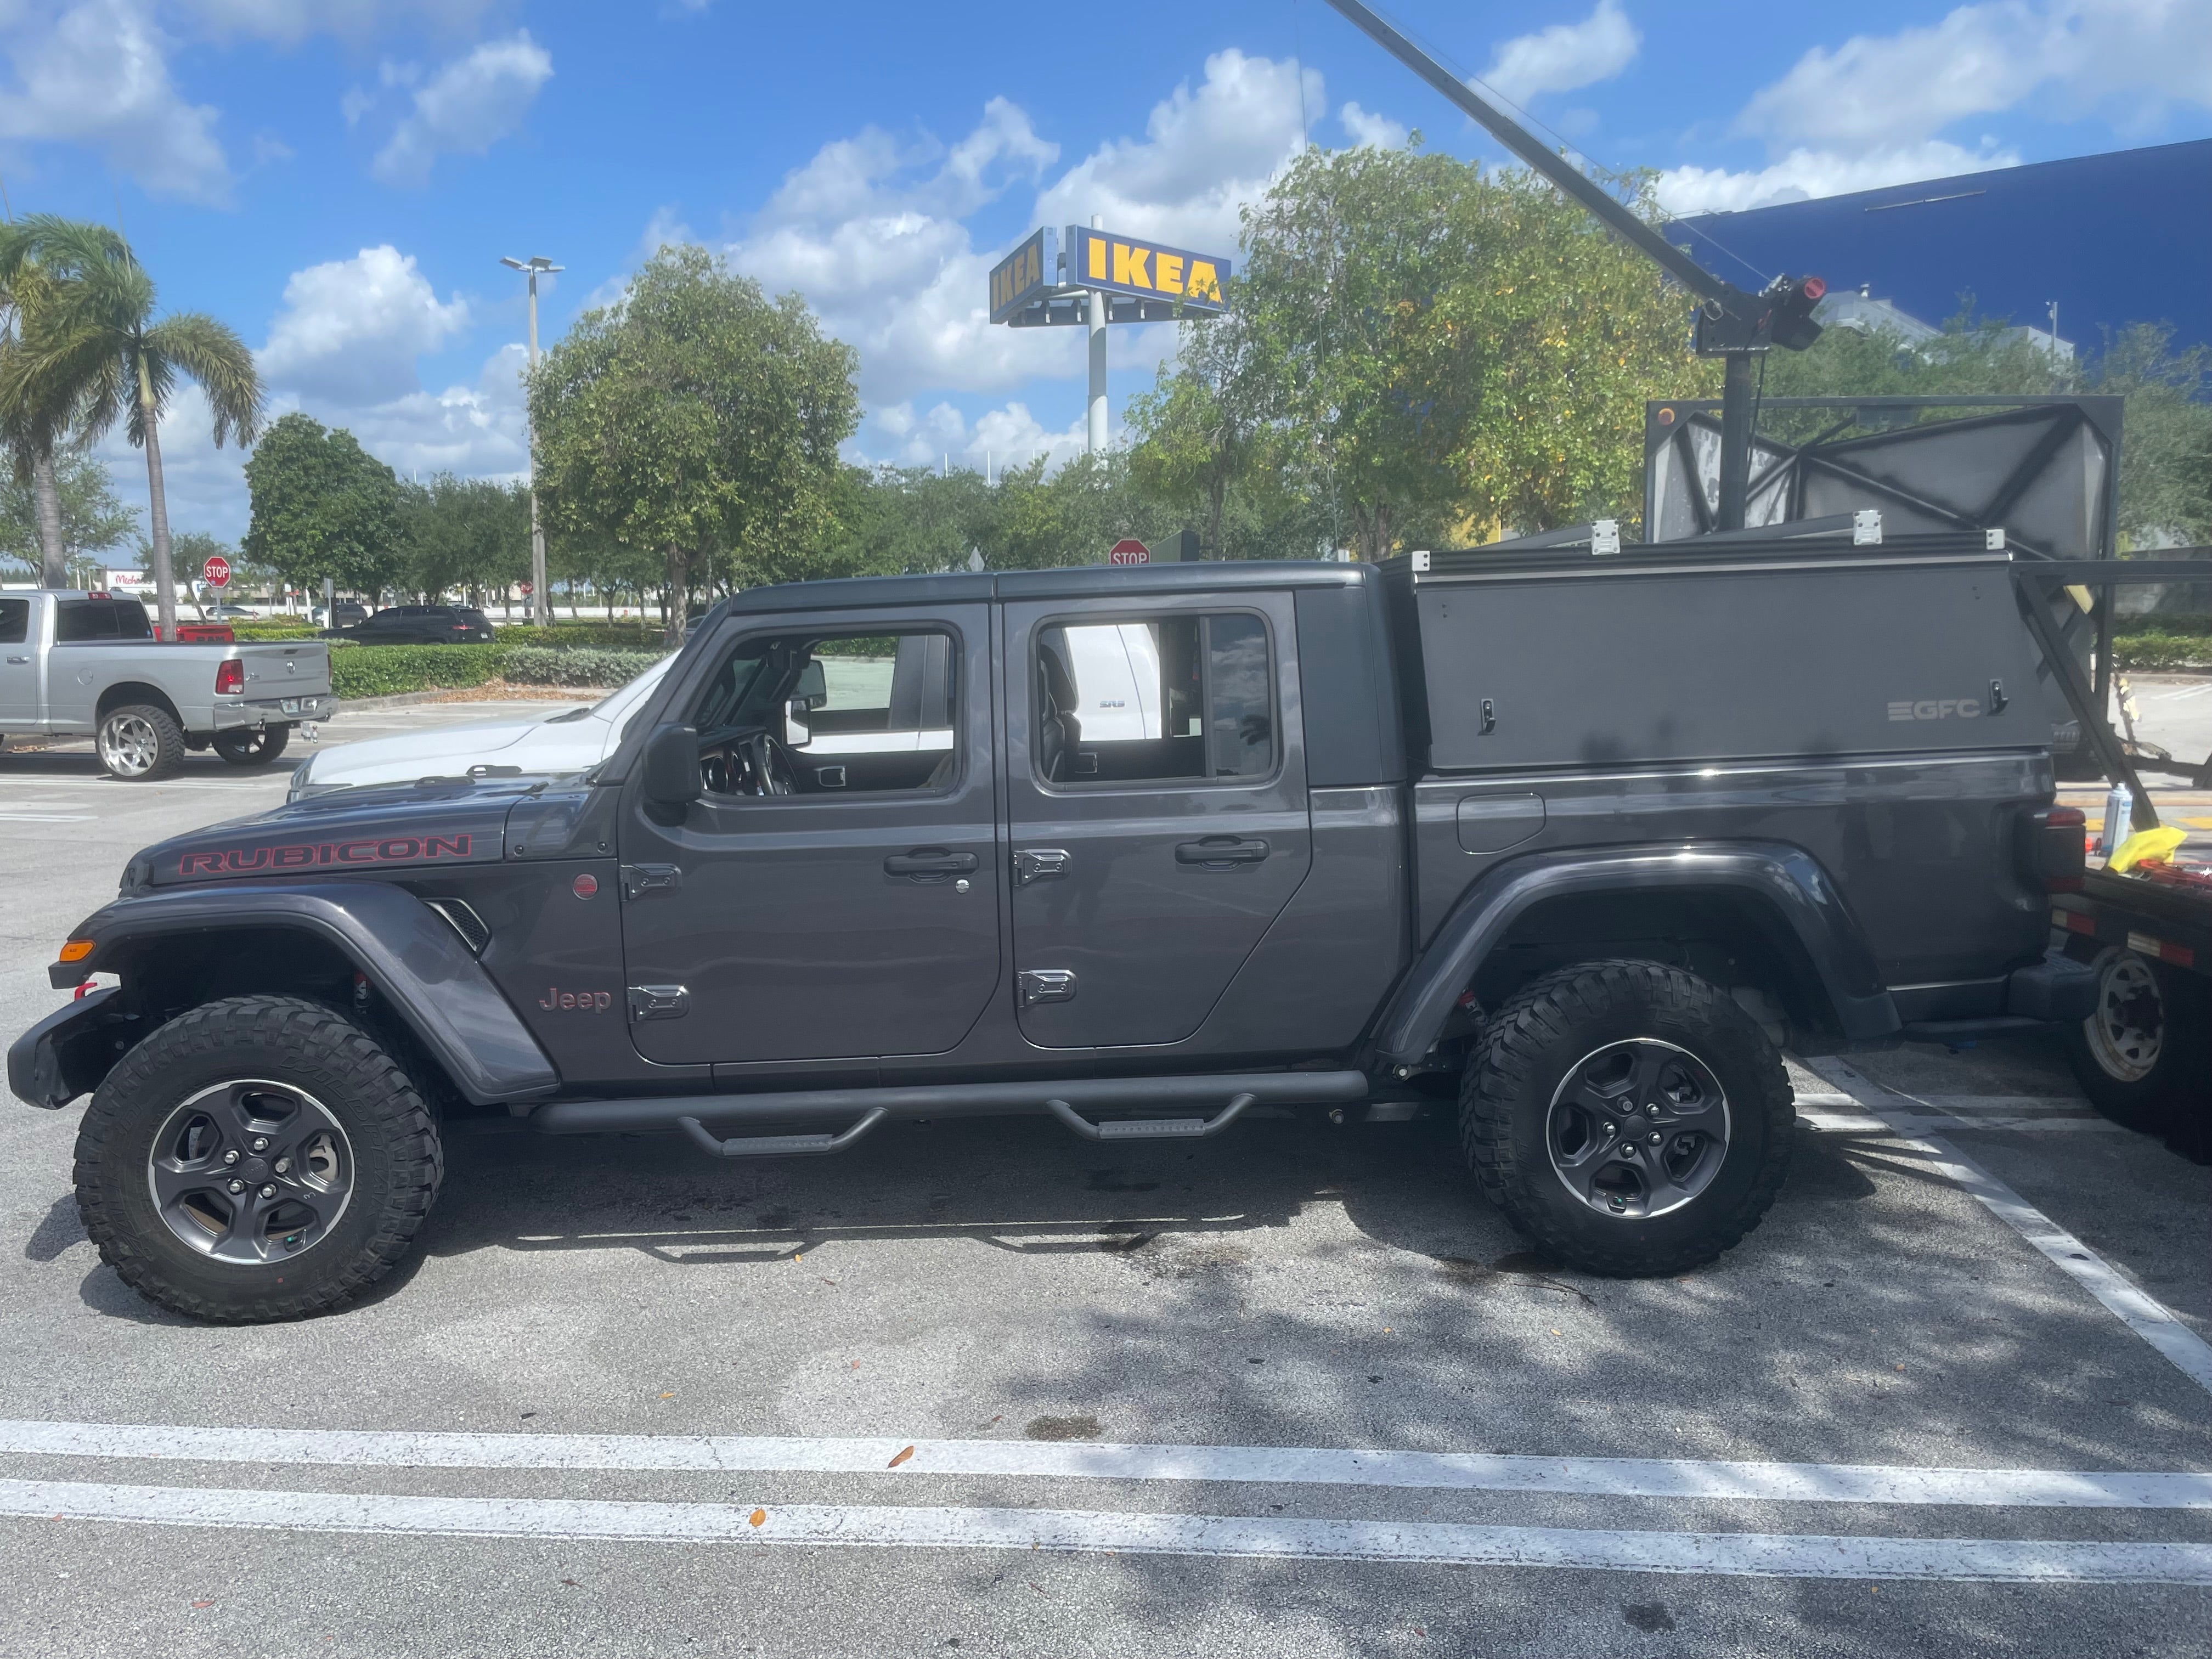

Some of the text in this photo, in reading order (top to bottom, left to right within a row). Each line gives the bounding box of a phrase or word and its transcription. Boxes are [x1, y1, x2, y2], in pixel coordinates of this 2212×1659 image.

[993, 242, 1041, 312] IKEA
[1088, 237, 1223, 303] IKEA
[206, 566, 228, 578] STOP
[1113, 552, 1147, 565] STOP
[179, 834, 471, 875] RUBICON
[539, 988, 612, 1014] Jeep
